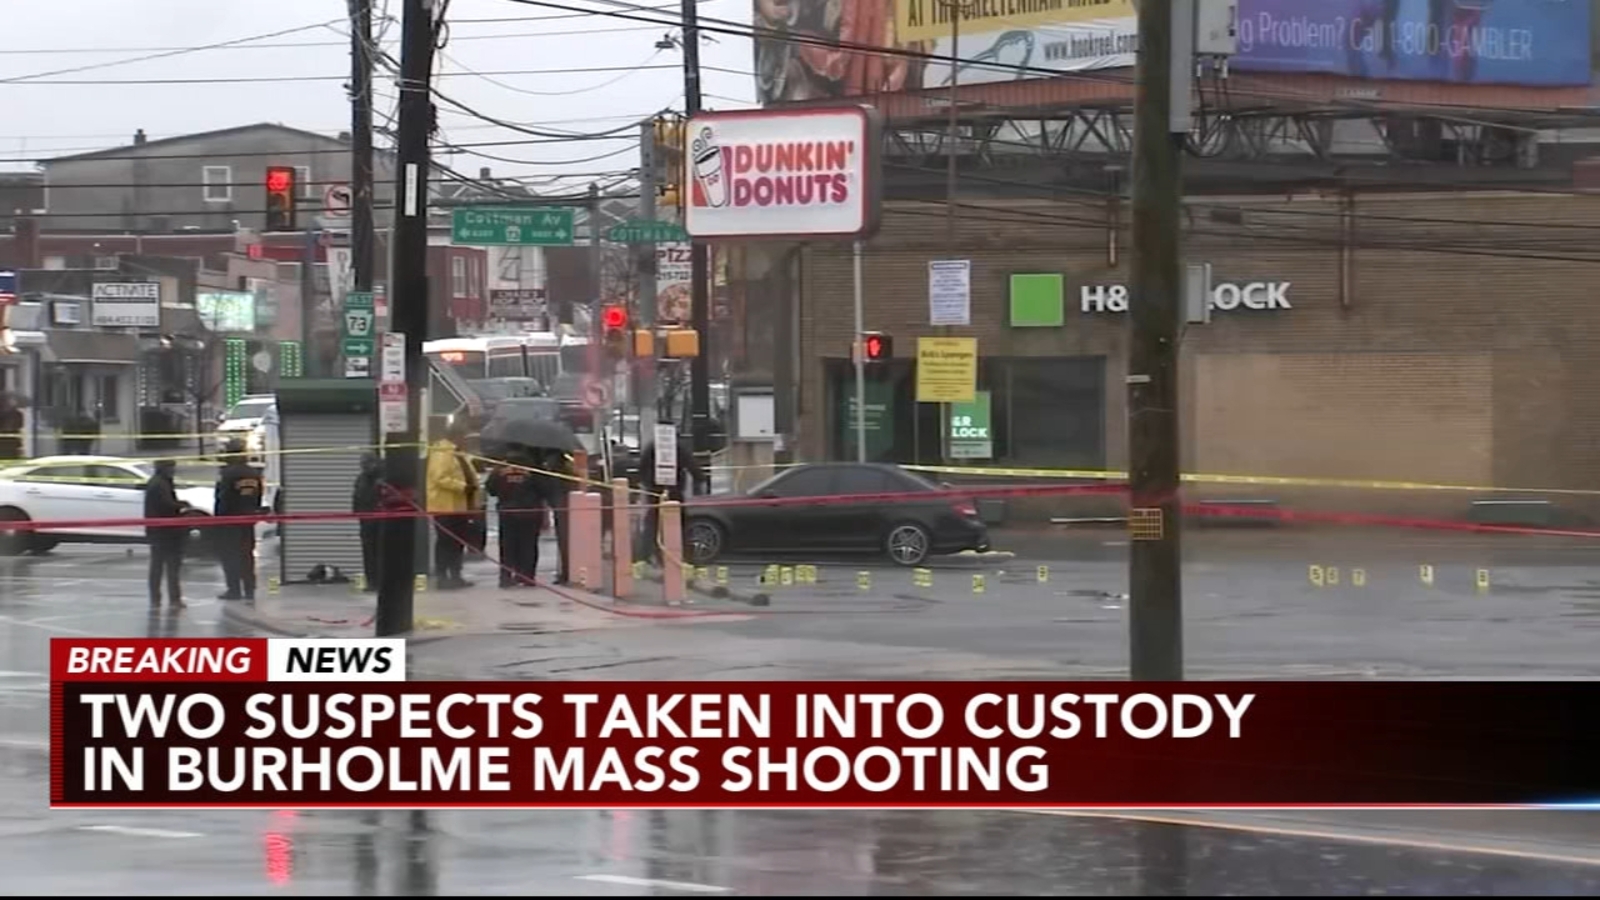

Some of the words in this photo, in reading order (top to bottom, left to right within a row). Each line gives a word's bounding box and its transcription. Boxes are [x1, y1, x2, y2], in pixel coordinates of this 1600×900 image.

[1259, 12, 1346, 50] Problem?
[1389, 20, 1533, 61] 1-800-GAMBLER
[735, 141, 854, 173] DUNKIN'
[734, 173, 848, 206] DONUTS
[465, 211, 532, 225] Cottman
[542, 212, 561, 225] Av
[1203, 281, 1293, 310] OCK
[350, 316, 367, 331] 73
